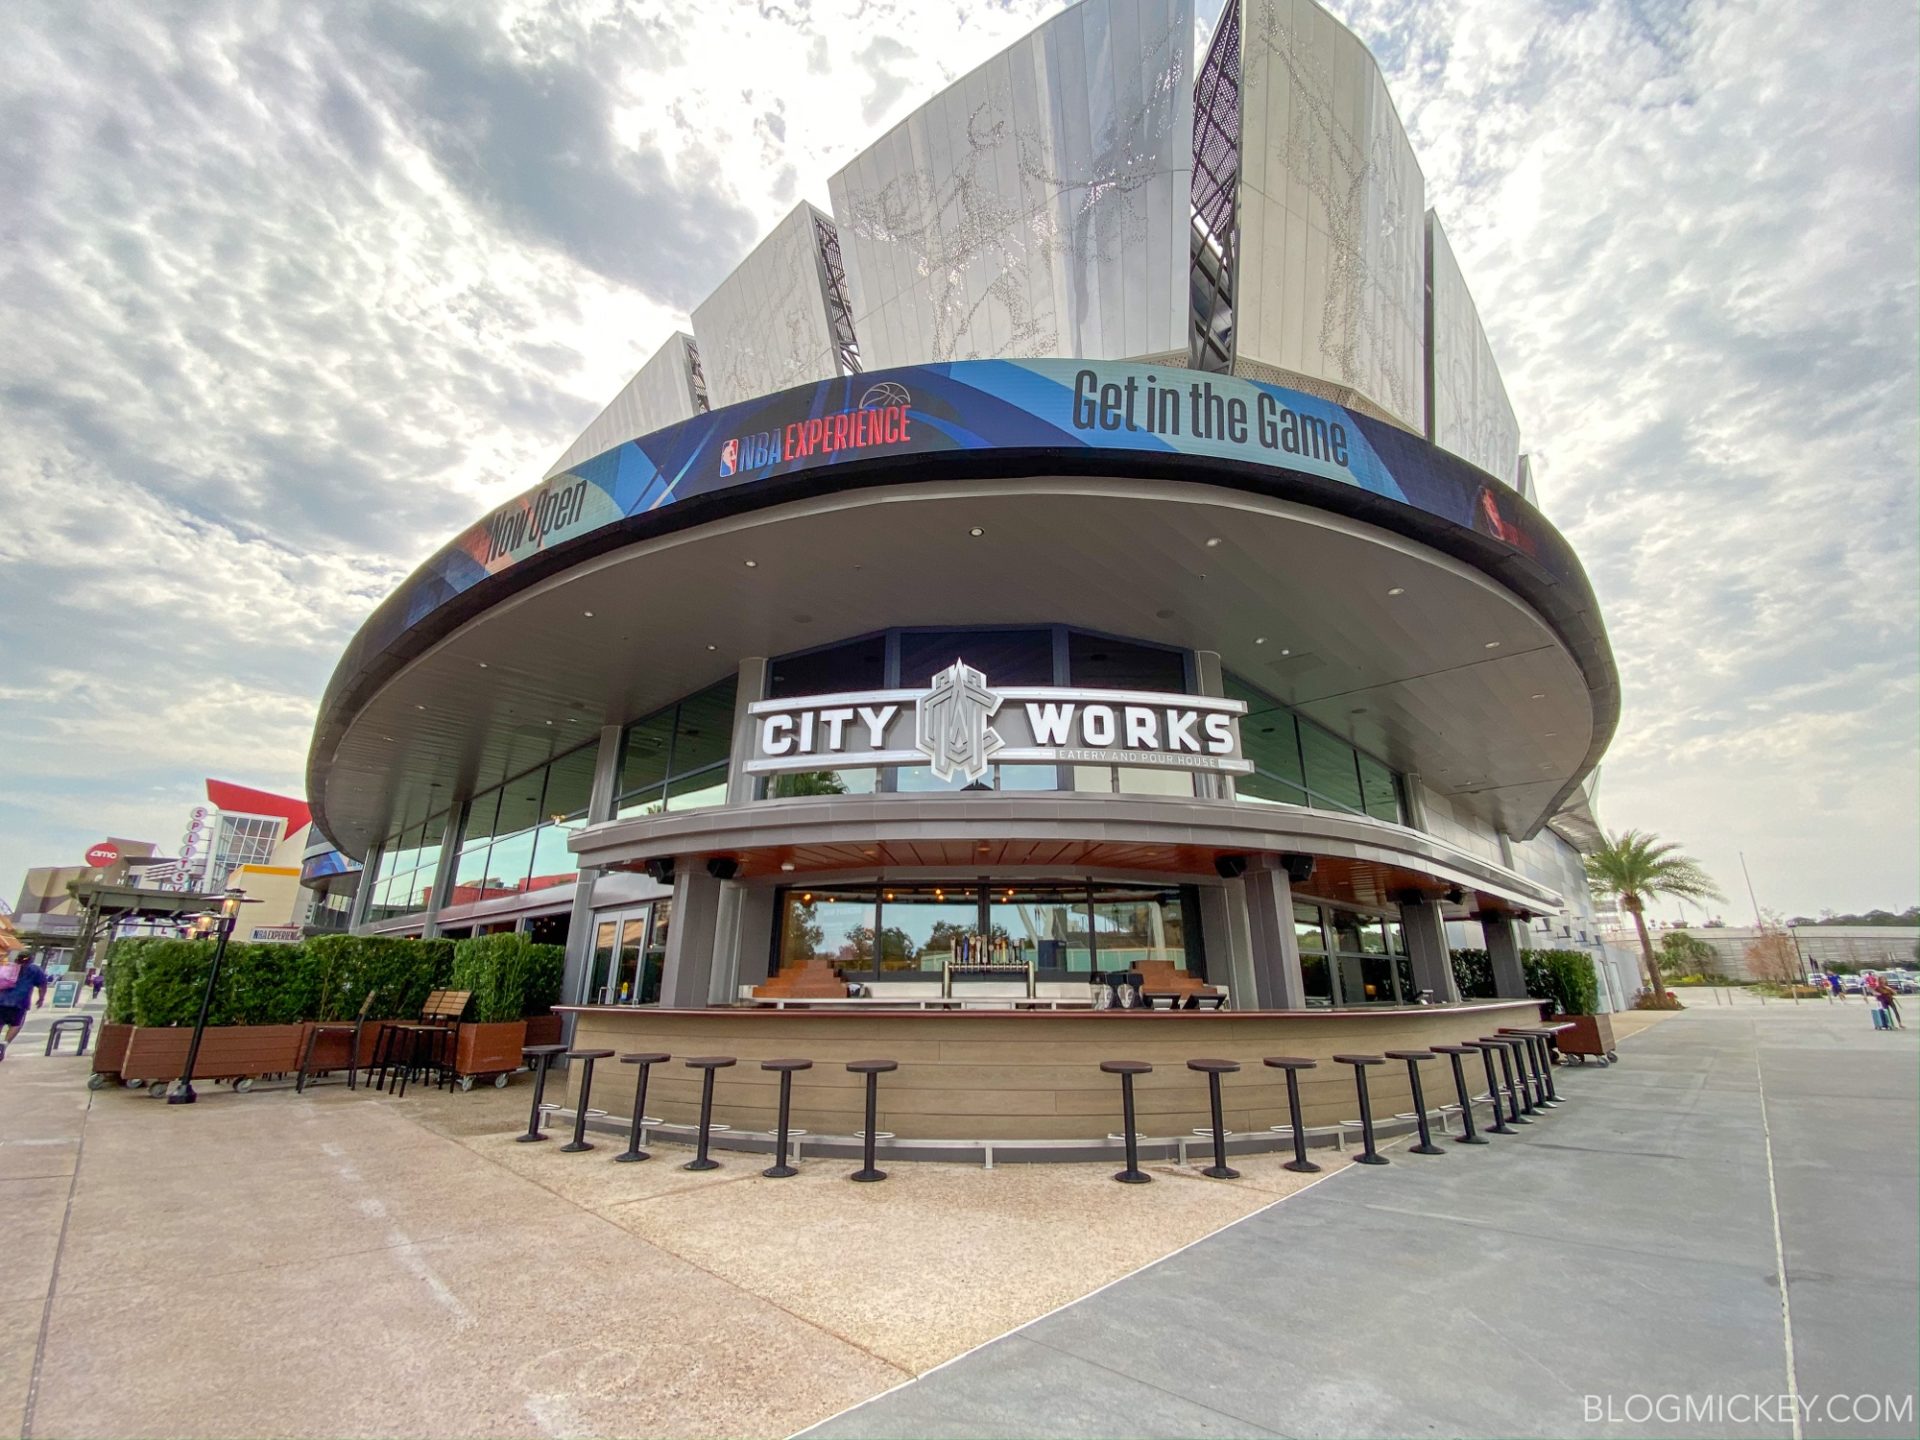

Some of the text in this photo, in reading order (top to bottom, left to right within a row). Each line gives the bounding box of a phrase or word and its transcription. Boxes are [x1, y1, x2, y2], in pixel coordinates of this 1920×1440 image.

[738, 404, 912, 473] NBA EXPERIENCE
[1074, 369, 1350, 468] Get in the Game
[485, 480, 588, 564] Now Open
[761, 702, 1235, 756] CITY WORKS
[1058, 750, 1216, 768] EATERY AND POUR HOUSE
